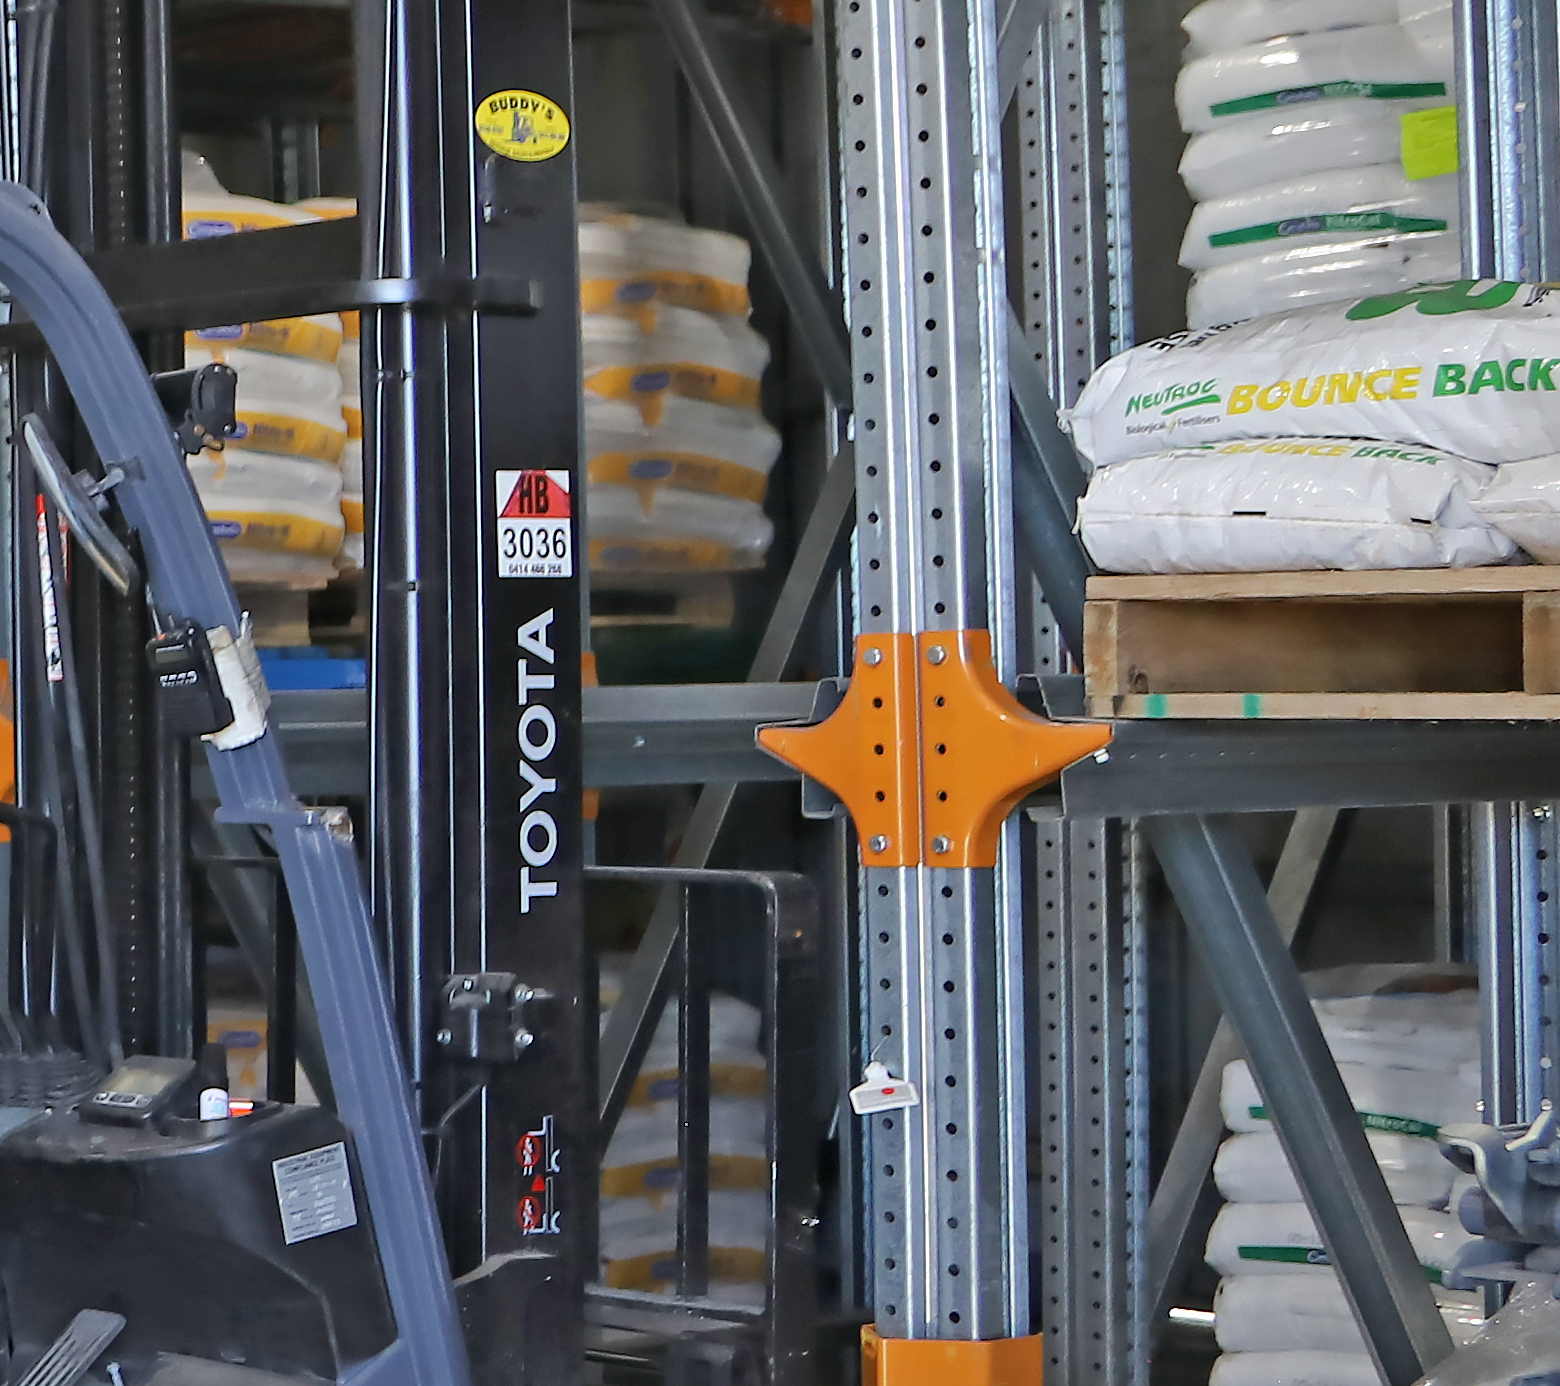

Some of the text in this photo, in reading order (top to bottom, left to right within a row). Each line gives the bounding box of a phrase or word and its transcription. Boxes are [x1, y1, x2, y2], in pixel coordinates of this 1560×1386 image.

[489, 97, 553, 121] BUDDY'S
[1126, 358, 1560, 416] NEUTROG BOUNCE BACK
[1351, 446, 1440, 466] BACK
[519, 474, 550, 515] HB
[503, 528, 567, 559] 3036
[517, 607, 559, 915] TOYOTA
